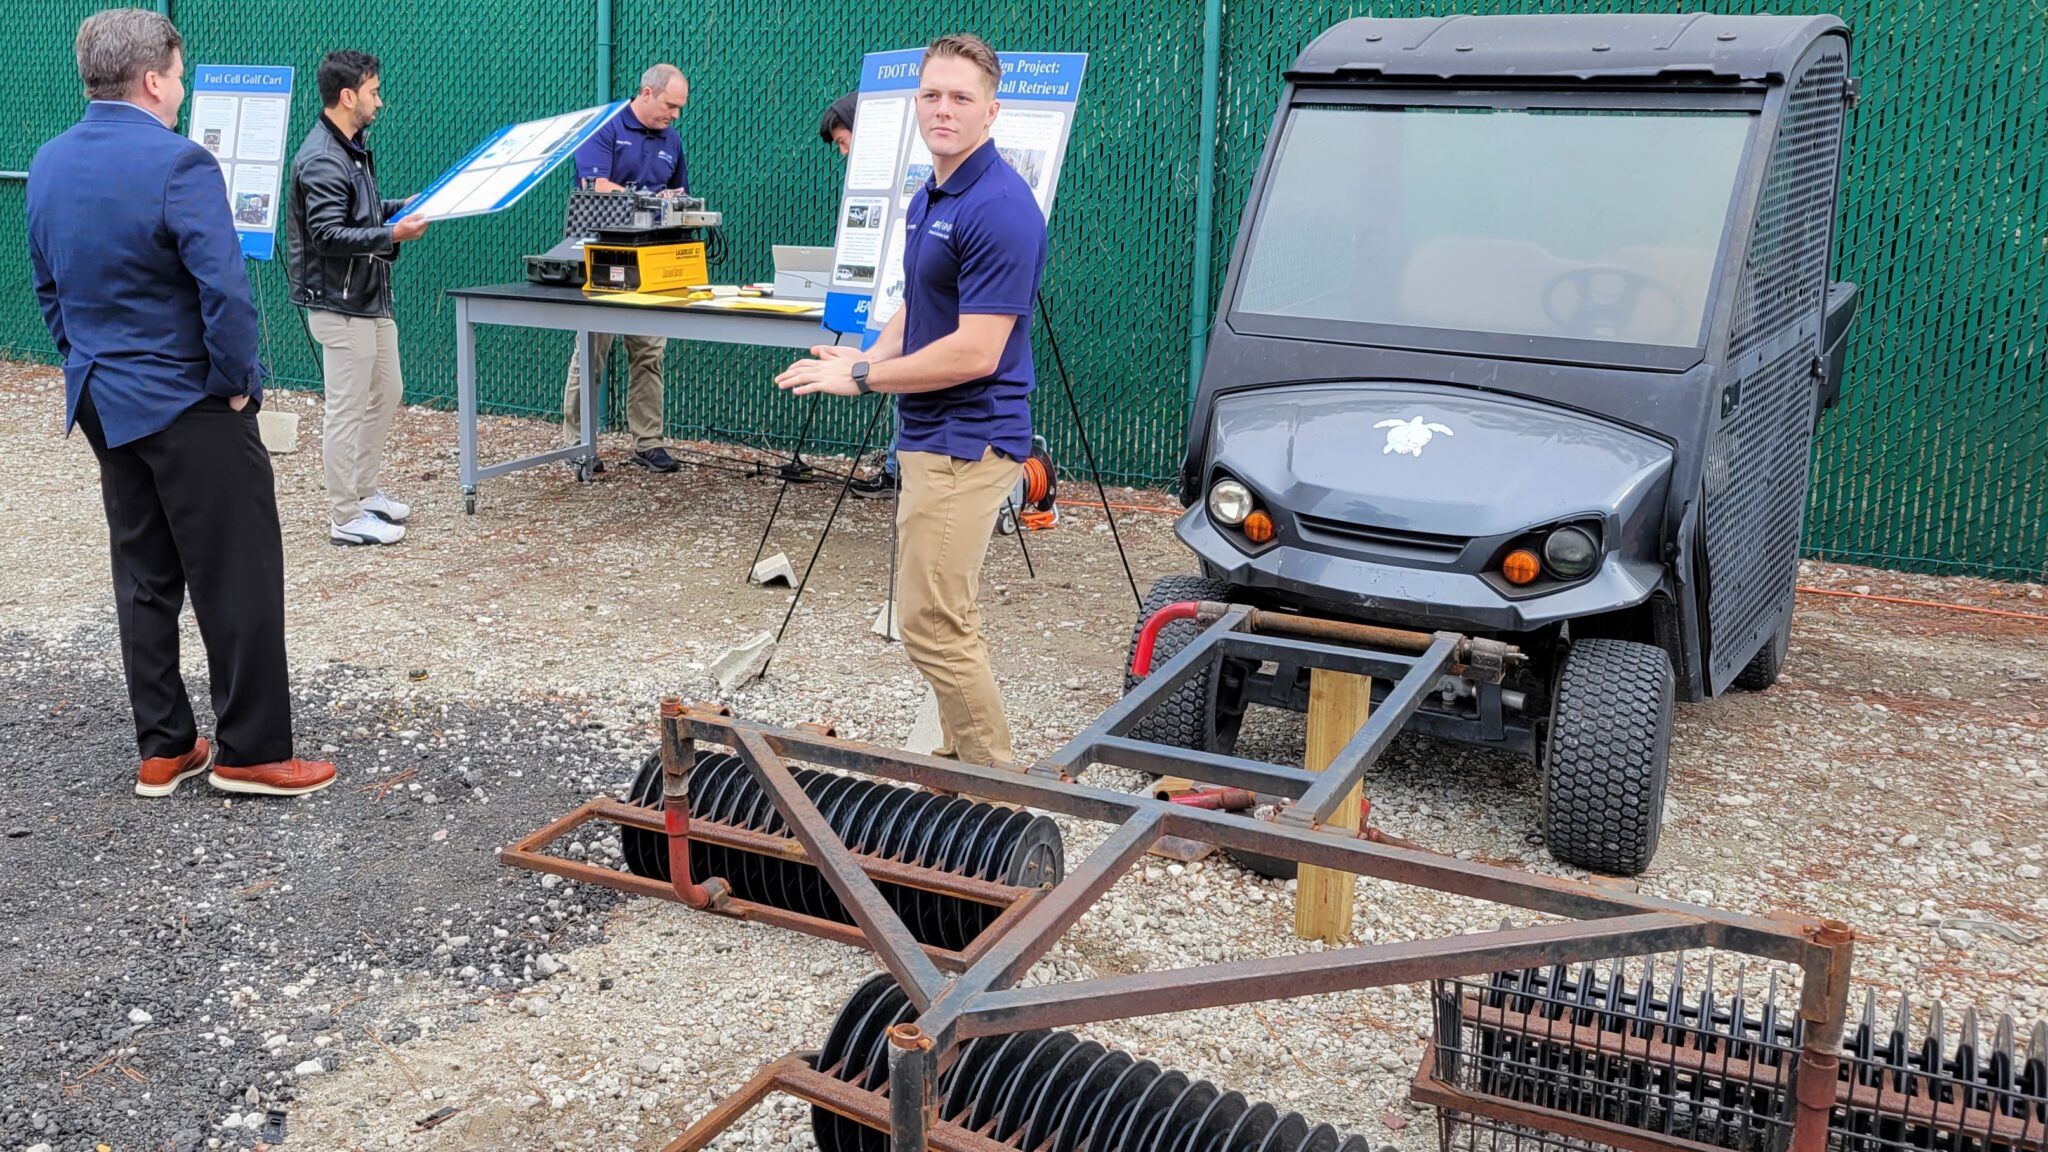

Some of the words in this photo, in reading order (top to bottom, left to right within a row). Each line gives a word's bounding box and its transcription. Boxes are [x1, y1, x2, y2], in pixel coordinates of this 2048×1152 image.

[877, 63, 907, 80] FDOT
[1016, 60, 1060, 77] Project:
[204, 73, 222, 84] Fuel
[224, 74, 240, 84] Cell
[242, 74, 261, 85] Golf
[262, 75, 282, 85] Cart
[1017, 81, 1070, 95] Retrieval
